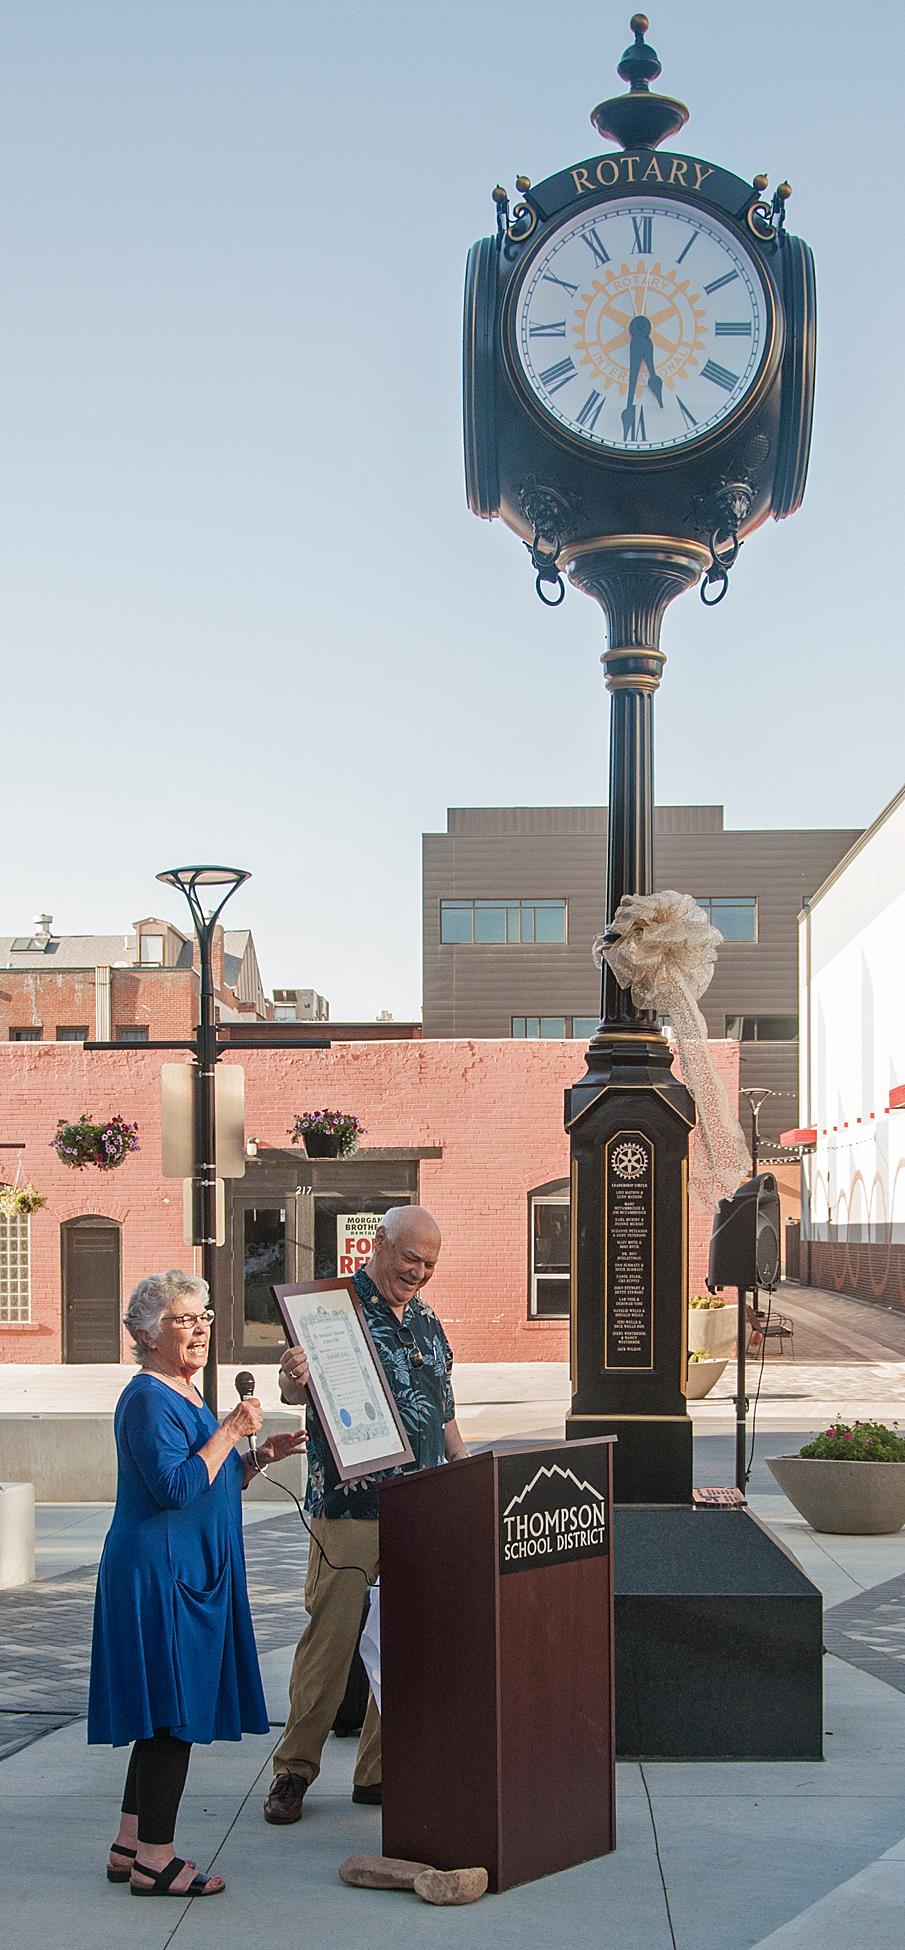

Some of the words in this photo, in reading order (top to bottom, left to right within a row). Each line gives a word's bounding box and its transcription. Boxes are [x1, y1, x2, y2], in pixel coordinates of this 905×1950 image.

[570, 156, 716, 196] ROTARY
[581, 228, 611, 269] XI
[631, 216, 654, 254] XII
[612, 274, 670, 293] ROTARY
[702, 269, 740, 296] II
[528, 319, 567, 338] IX
[714, 320, 752, 337] III
[538, 355, 579, 396] VIII
[699, 358, 741, 394] IIII
[574, 388, 607, 432] VII
[295, 1185, 313, 1195] 217
[503, 1501, 605, 1542] THOMPSON
[504, 1536, 553, 1561] SCHOOL
[556, 1527, 605, 1551] DISTRICT
